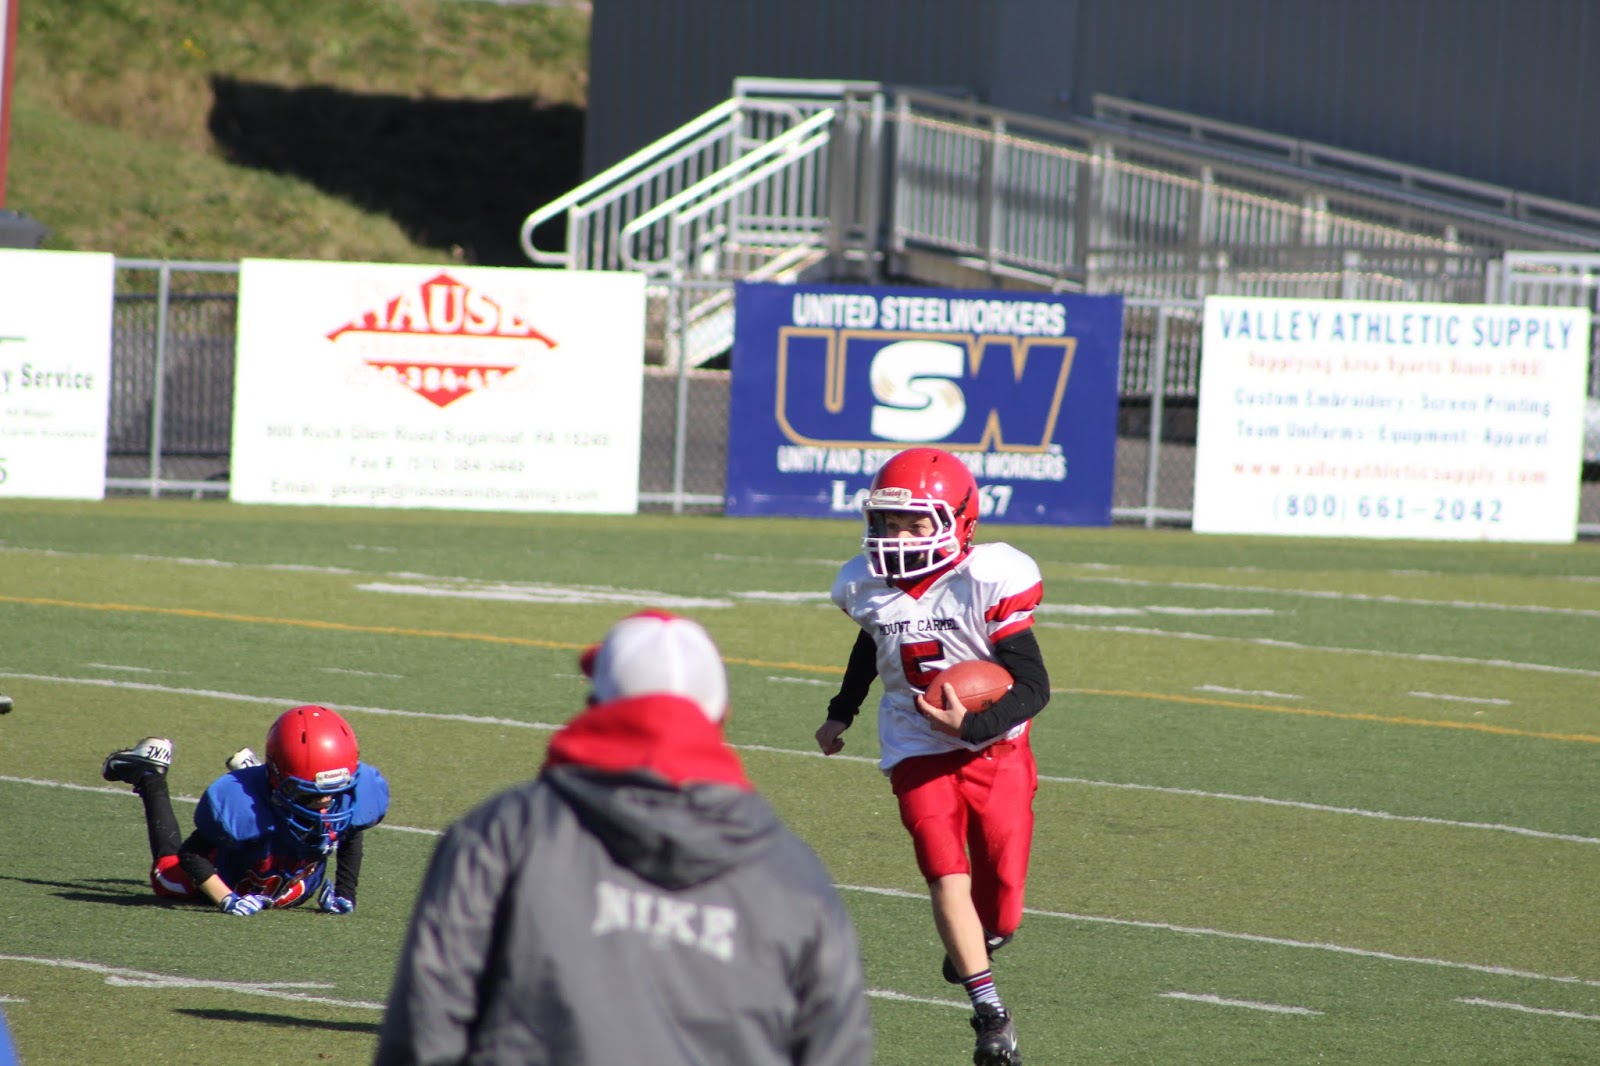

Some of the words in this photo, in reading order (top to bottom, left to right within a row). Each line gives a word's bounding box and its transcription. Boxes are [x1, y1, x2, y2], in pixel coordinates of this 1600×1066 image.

[793, 293, 877, 328] UNITED
[880, 297, 1067, 336] STEELWORKERS
[1220, 309, 1320, 342] VALLEY
[1330, 312, 1460, 347] ATHLETIC
[1472, 315, 1573, 350] SUPPLY
[21, 361, 96, 391] Service
[775, 326, 1077, 453] USW
[1233, 386, 1299, 406] Custom
[1304, 388, 1404, 413] Embroidery
[1420, 391, 1478, 412] Screen
[1483, 393, 1552, 417] Printing
[1235, 418, 1280, 438] Team
[1286, 421, 1364, 440] Uniforms
[1377, 424, 1468, 445] Equipment
[1483, 426, 1549, 448] Apparel
[777, 445, 828, 473] UNITY
[825, 446, 862, 475] AND
[984, 452, 1067, 482] WORKERS
[978, 485, 1013, 516] 67
[1273, 494, 1346, 524] (800)
[1357, 495, 1503, 524] 661-2042
[879, 620, 911, 636] MOUNT
[917, 617, 960, 632] CARMEL
[591, 880, 738, 962] NIKE
